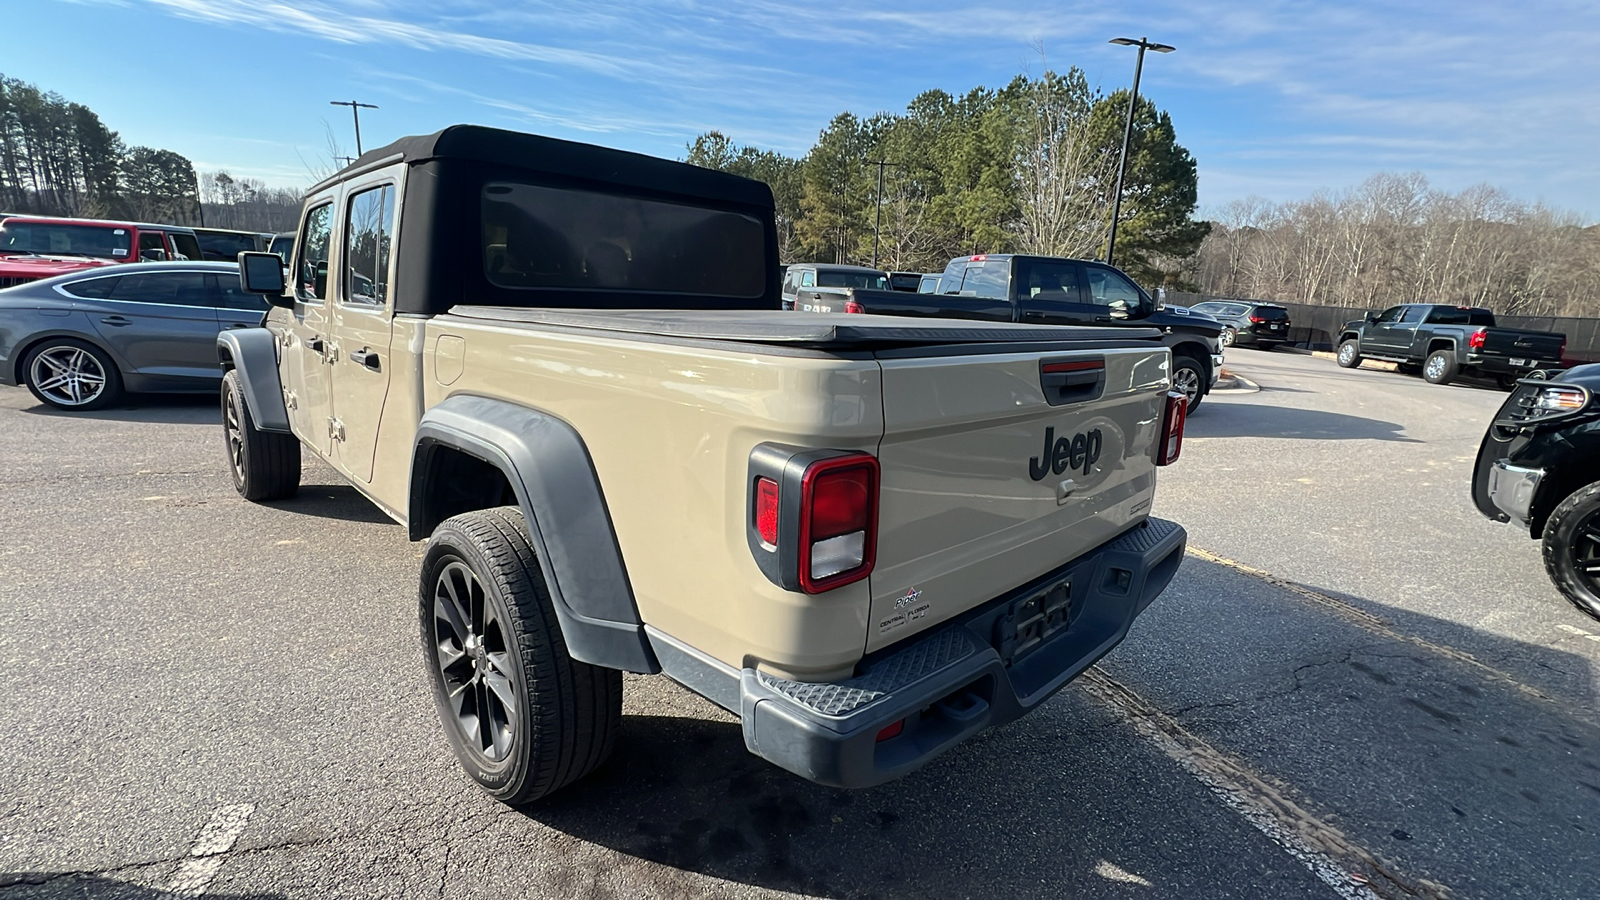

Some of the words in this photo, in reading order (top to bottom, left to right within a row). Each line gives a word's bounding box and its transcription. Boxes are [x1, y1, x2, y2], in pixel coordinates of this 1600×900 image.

[1029, 426, 1102, 482] Jeep
[894, 591, 922, 609] Piper
[880, 614, 905, 628] CENTRAL
[907, 604, 930, 617] FLORIDA
